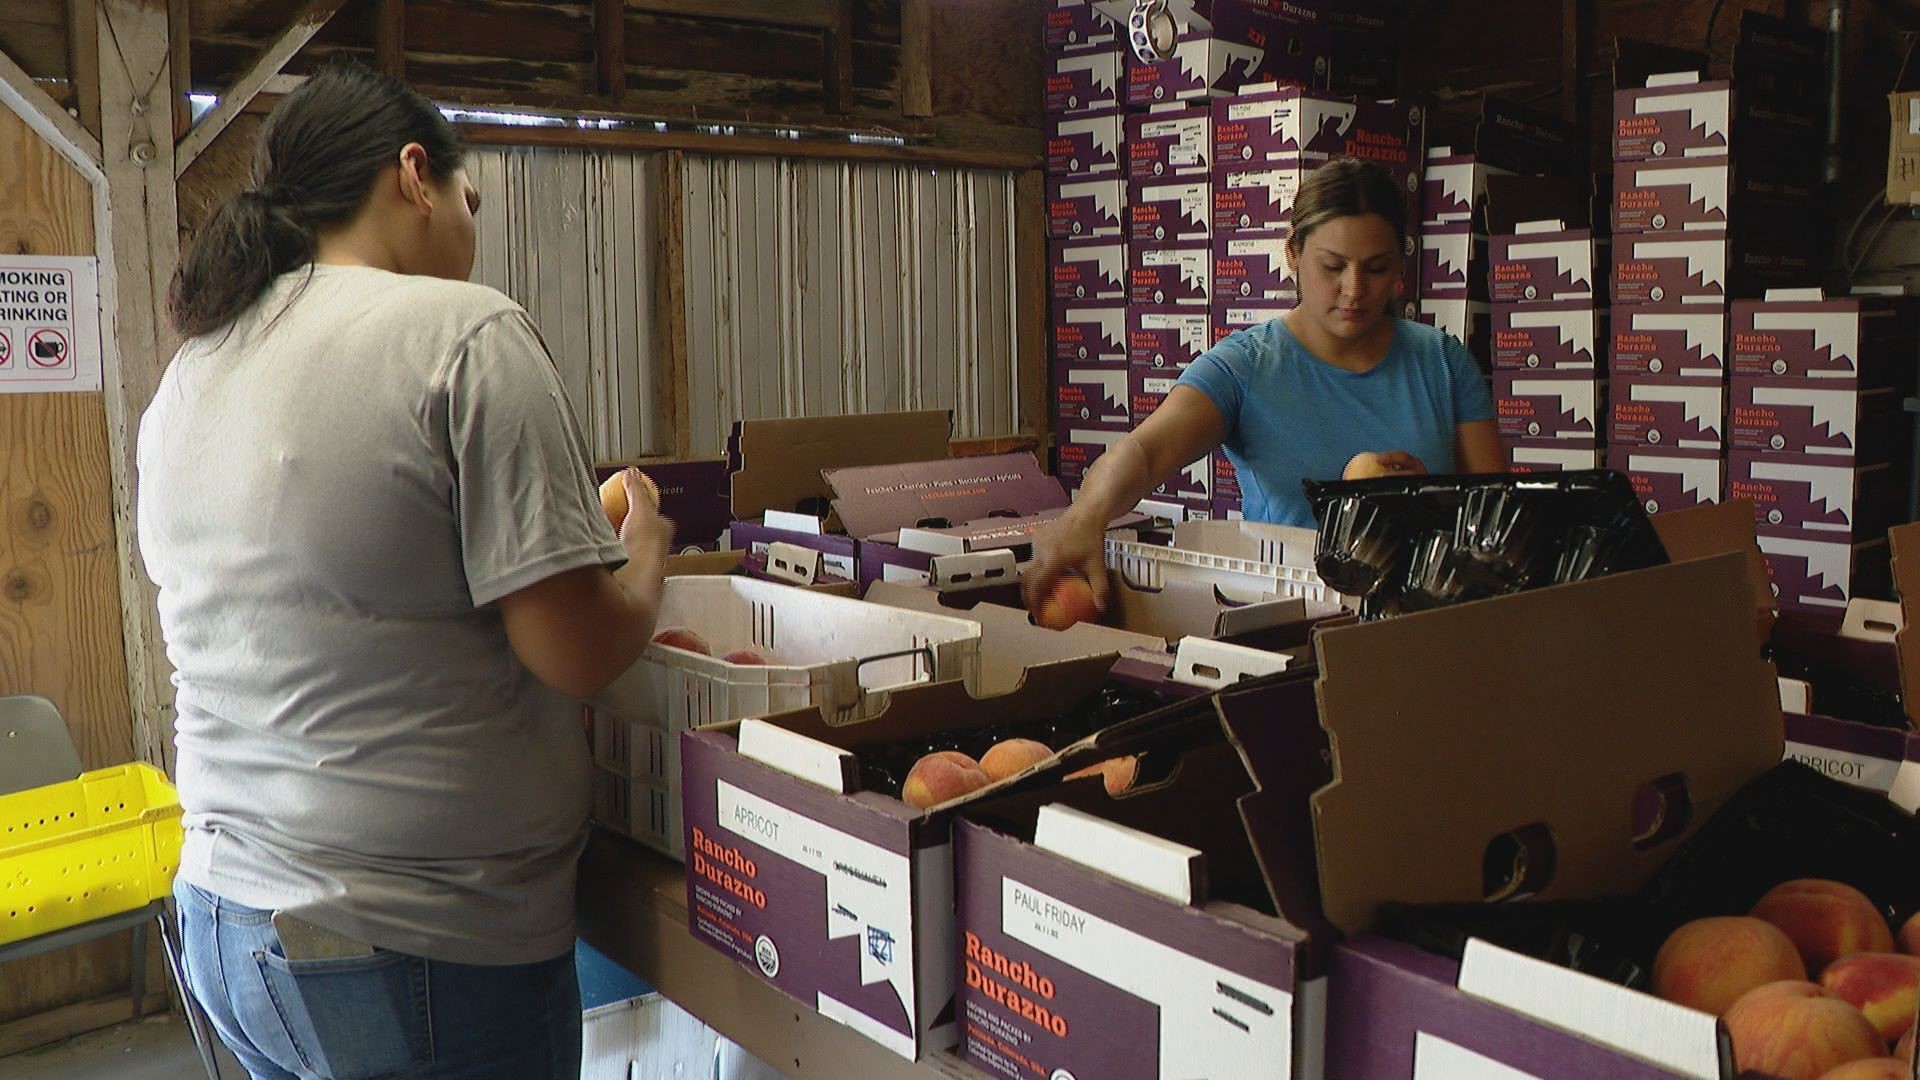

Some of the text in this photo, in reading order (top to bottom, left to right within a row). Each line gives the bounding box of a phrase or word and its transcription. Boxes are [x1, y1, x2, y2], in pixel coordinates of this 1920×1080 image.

[1282, 1, 1317, 18] Durazno
[1619, 118, 1657, 127] Rancho
[1217, 124, 1245, 132] Rancho
[1619, 126, 1661, 136] Durazno
[1217, 132, 1248, 141] Durazno
[1356, 128, 1402, 145] Rancho
[1345, 140, 1406, 161] Durazno
[1215, 192, 1243, 200] Rancho
[1620, 191, 1656, 200] Rancho
[1215, 200, 1246, 209] Durazno
[1620, 199, 1661, 208] Durazno
[1216, 259, 1243, 267] Rancho
[1618, 263, 1654, 272] Rancho
[1216, 267, 1247, 276] Durazno
[1494, 264, 1527, 272] Rancho
[1494, 272, 1532, 280] Durazno
[1618, 271, 1658, 280] Durazno
[0, 290, 67, 304] TING OR
[1497, 332, 1530, 340] Rancho
[1617, 334, 1653, 343] Rancho
[1736, 334, 1776, 343] Rancho
[1497, 340, 1534, 348] Durazno
[1617, 342, 1657, 351] Durazno
[1736, 342, 1781, 352] Durazno
[1498, 400, 1531, 408] Rancho
[1498, 408, 1535, 416] Durazno
[1615, 404, 1651, 414] Rancho
[1735, 408, 1774, 417] Rancho
[1615, 412, 1655, 422] Durazno
[1735, 416, 1780, 427] Durazno
[1216, 468, 1233, 477] Dura
[1631, 476, 1649, 484] cho
[1733, 481, 1772, 492] Rancho
[734, 804, 779, 840] APRICOT
[692, 827, 757, 879] Rancho
[692, 854, 768, 910] Durazno
[1014, 888, 1086, 934] PAUL FRIDAY
[966, 931, 1056, 1000] Rancho
[966, 962, 1068, 1038] Durazno
